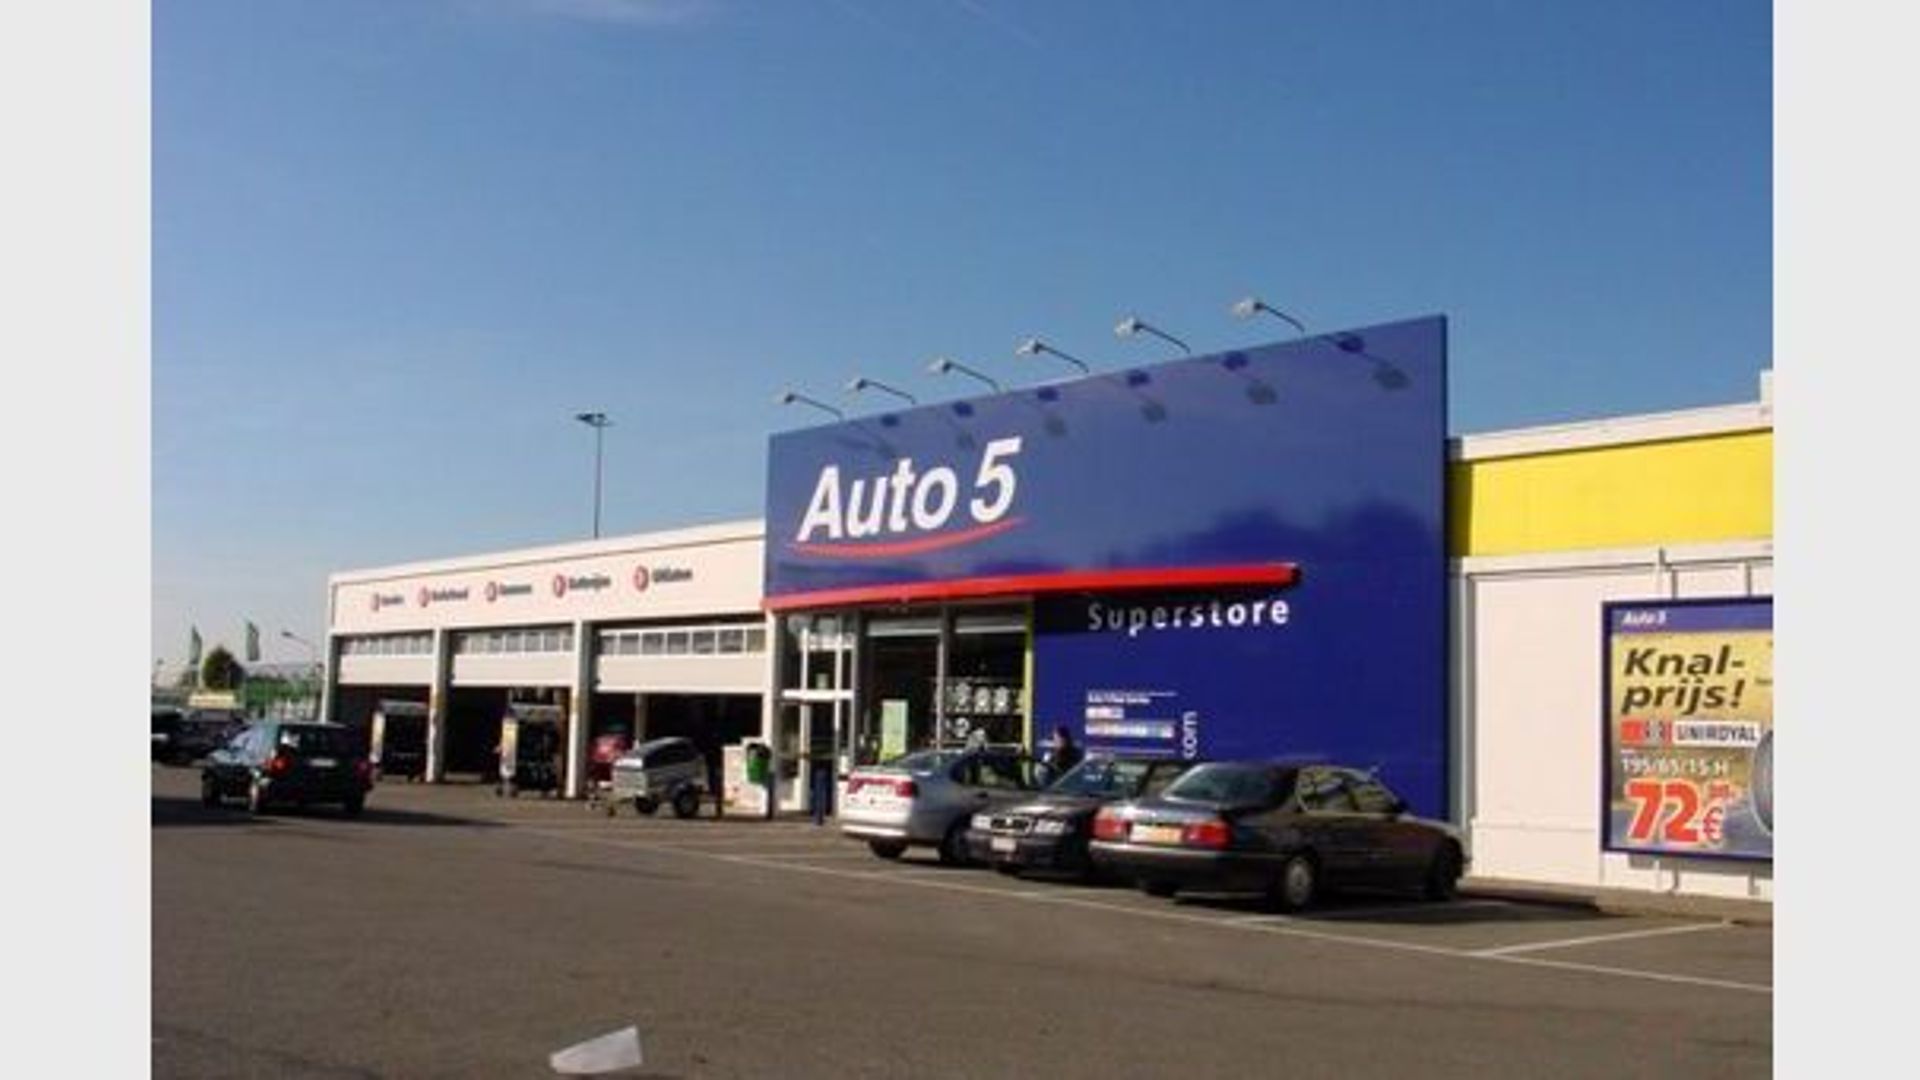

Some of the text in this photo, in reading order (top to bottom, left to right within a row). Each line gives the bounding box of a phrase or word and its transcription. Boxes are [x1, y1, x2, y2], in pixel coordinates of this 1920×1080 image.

[797, 436, 1022, 541] Auto 5
[1087, 599, 1290, 637] Superstore
[1624, 644, 1746, 677] Knal-
[1620, 677, 1746, 716] prijs!
[1677, 723, 1758, 741] UNIROYAL
[1626, 778, 1700, 843] 72
